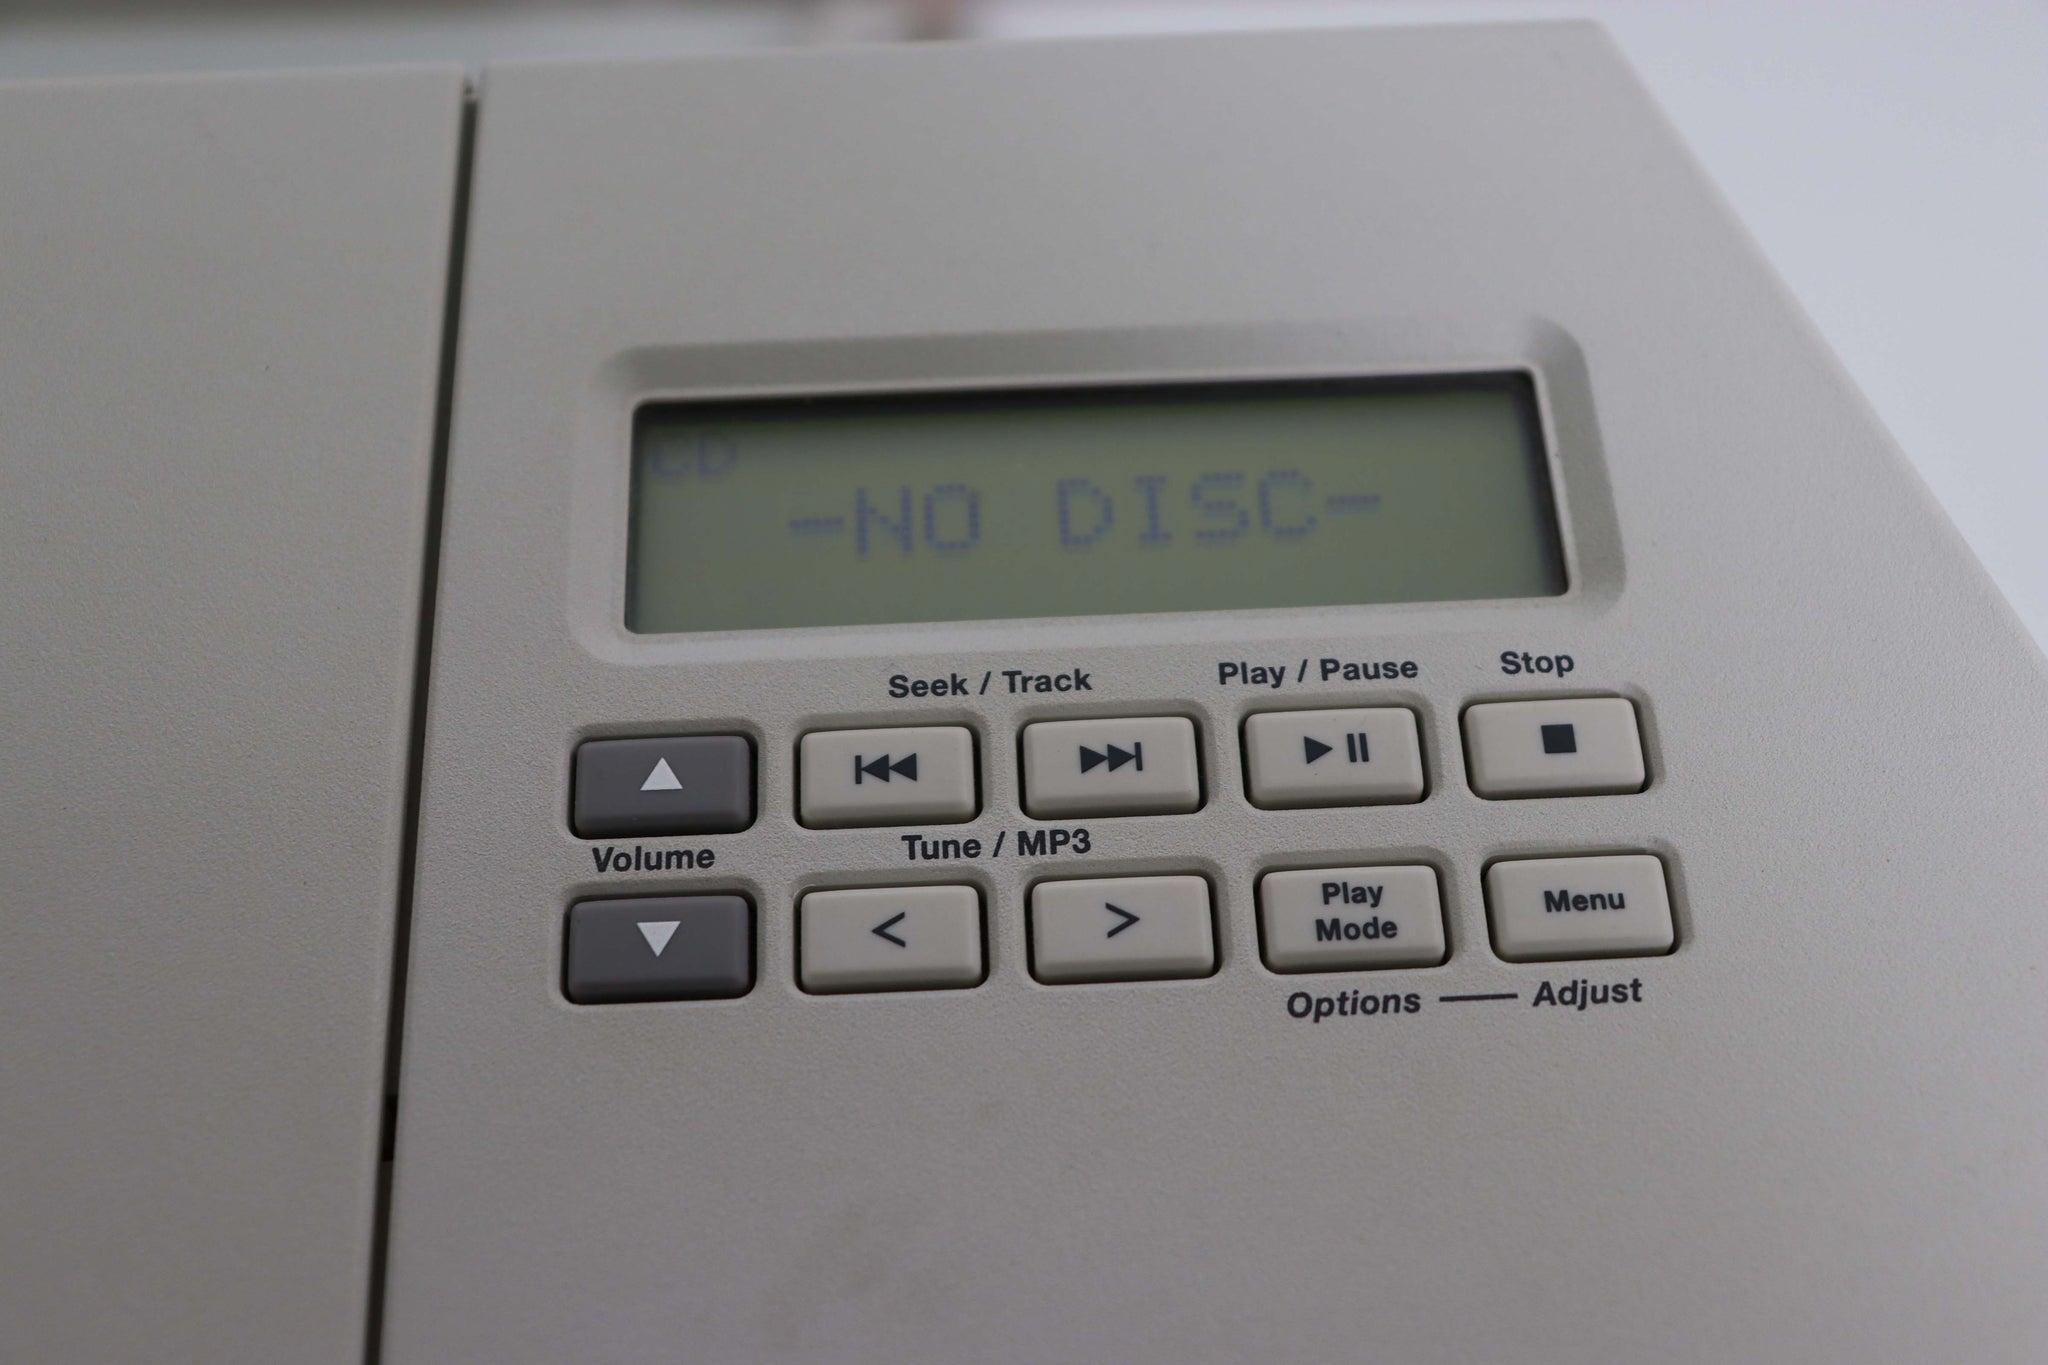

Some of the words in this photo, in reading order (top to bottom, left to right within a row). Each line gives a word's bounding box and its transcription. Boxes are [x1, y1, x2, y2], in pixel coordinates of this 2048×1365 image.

[1218, 662, 1286, 688] Play
[1320, 658, 1418, 681] Pause
[1500, 651, 1575, 677] Stop
[888, 673, 969, 698] Seek
[1002, 669, 1093, 693] Track
[901, 834, 982, 860] Tune
[1017, 828, 1092, 857] MP3
[592, 846, 716, 872] Volume
[1321, 882, 1384, 908] Play
[1543, 890, 1626, 913] Menu
[1315, 916, 1399, 942] Mode
[1286, 989, 1422, 1023] Options
[1532, 978, 1643, 1011] Adjust
